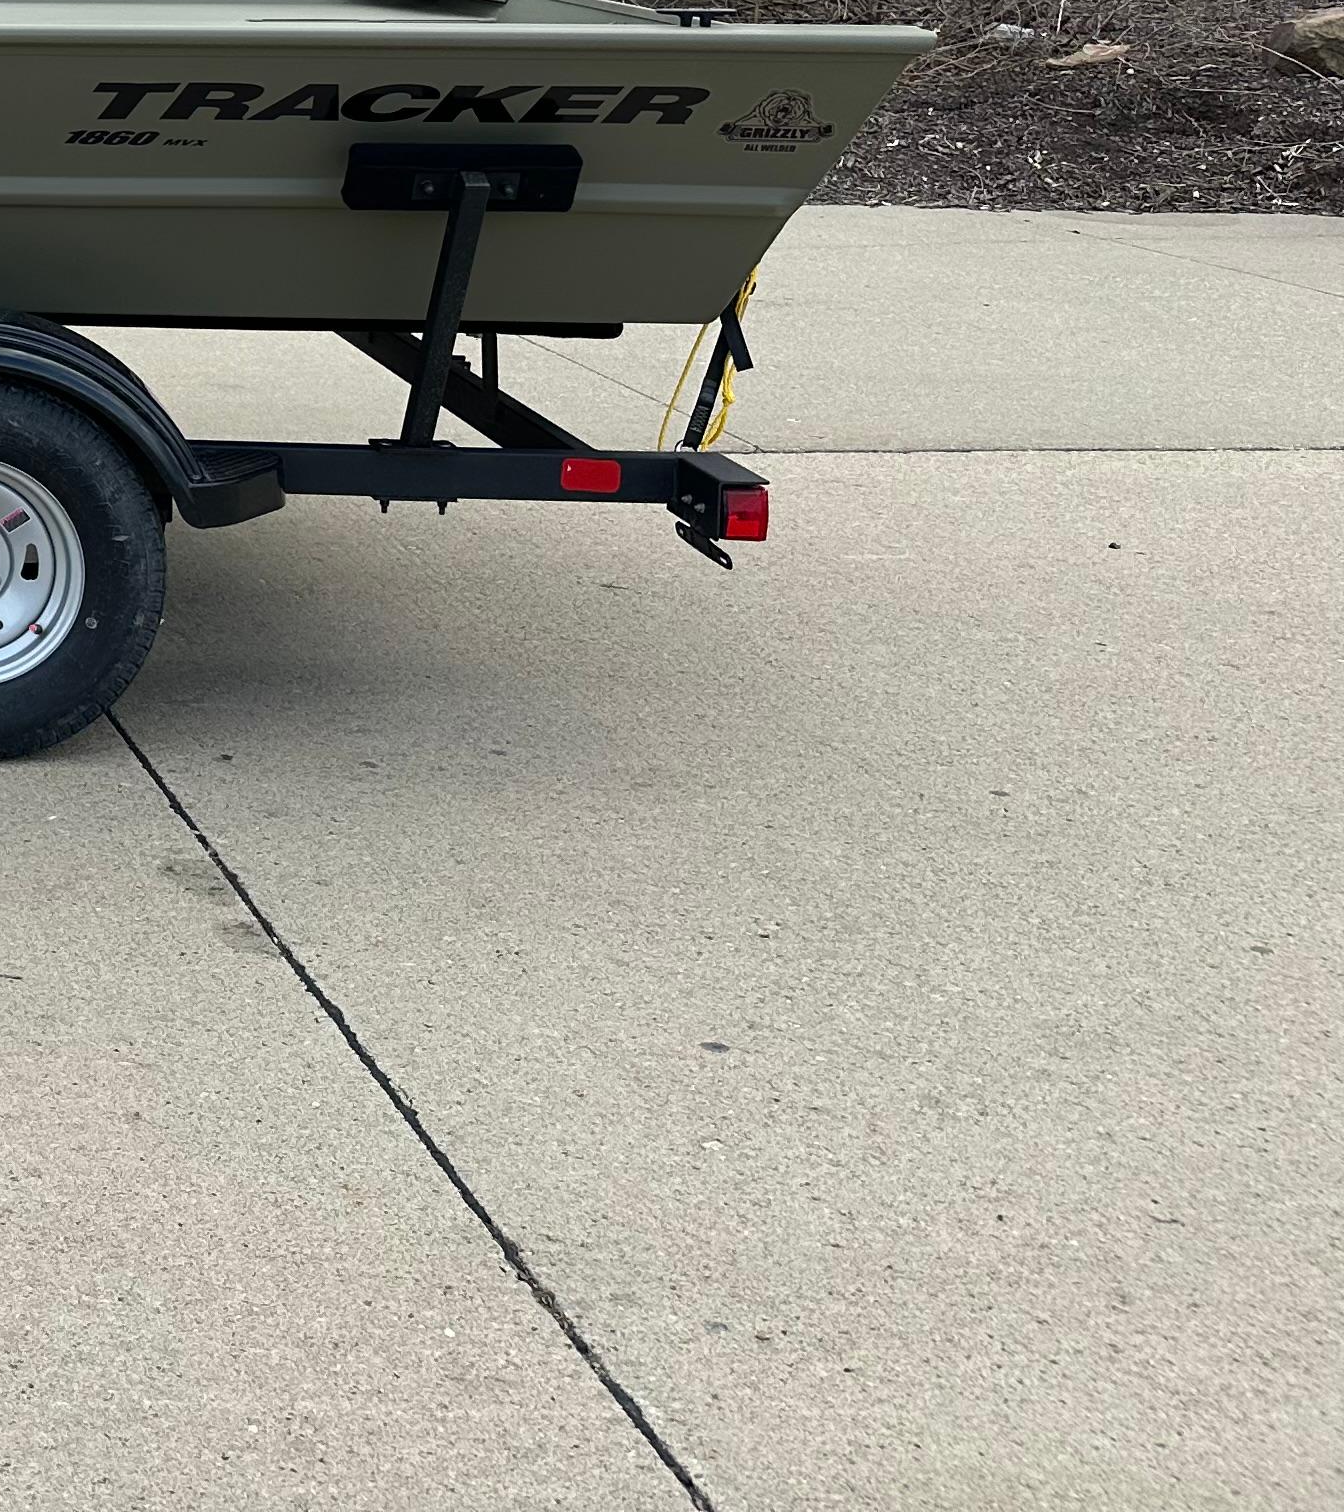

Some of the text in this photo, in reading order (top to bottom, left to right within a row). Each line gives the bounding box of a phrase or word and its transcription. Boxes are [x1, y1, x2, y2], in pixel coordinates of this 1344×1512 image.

[92, 82, 711, 125] TRACKER
[64, 129, 209, 147] 1860 MVX
[739, 127, 811, 139] GRIZZLY
